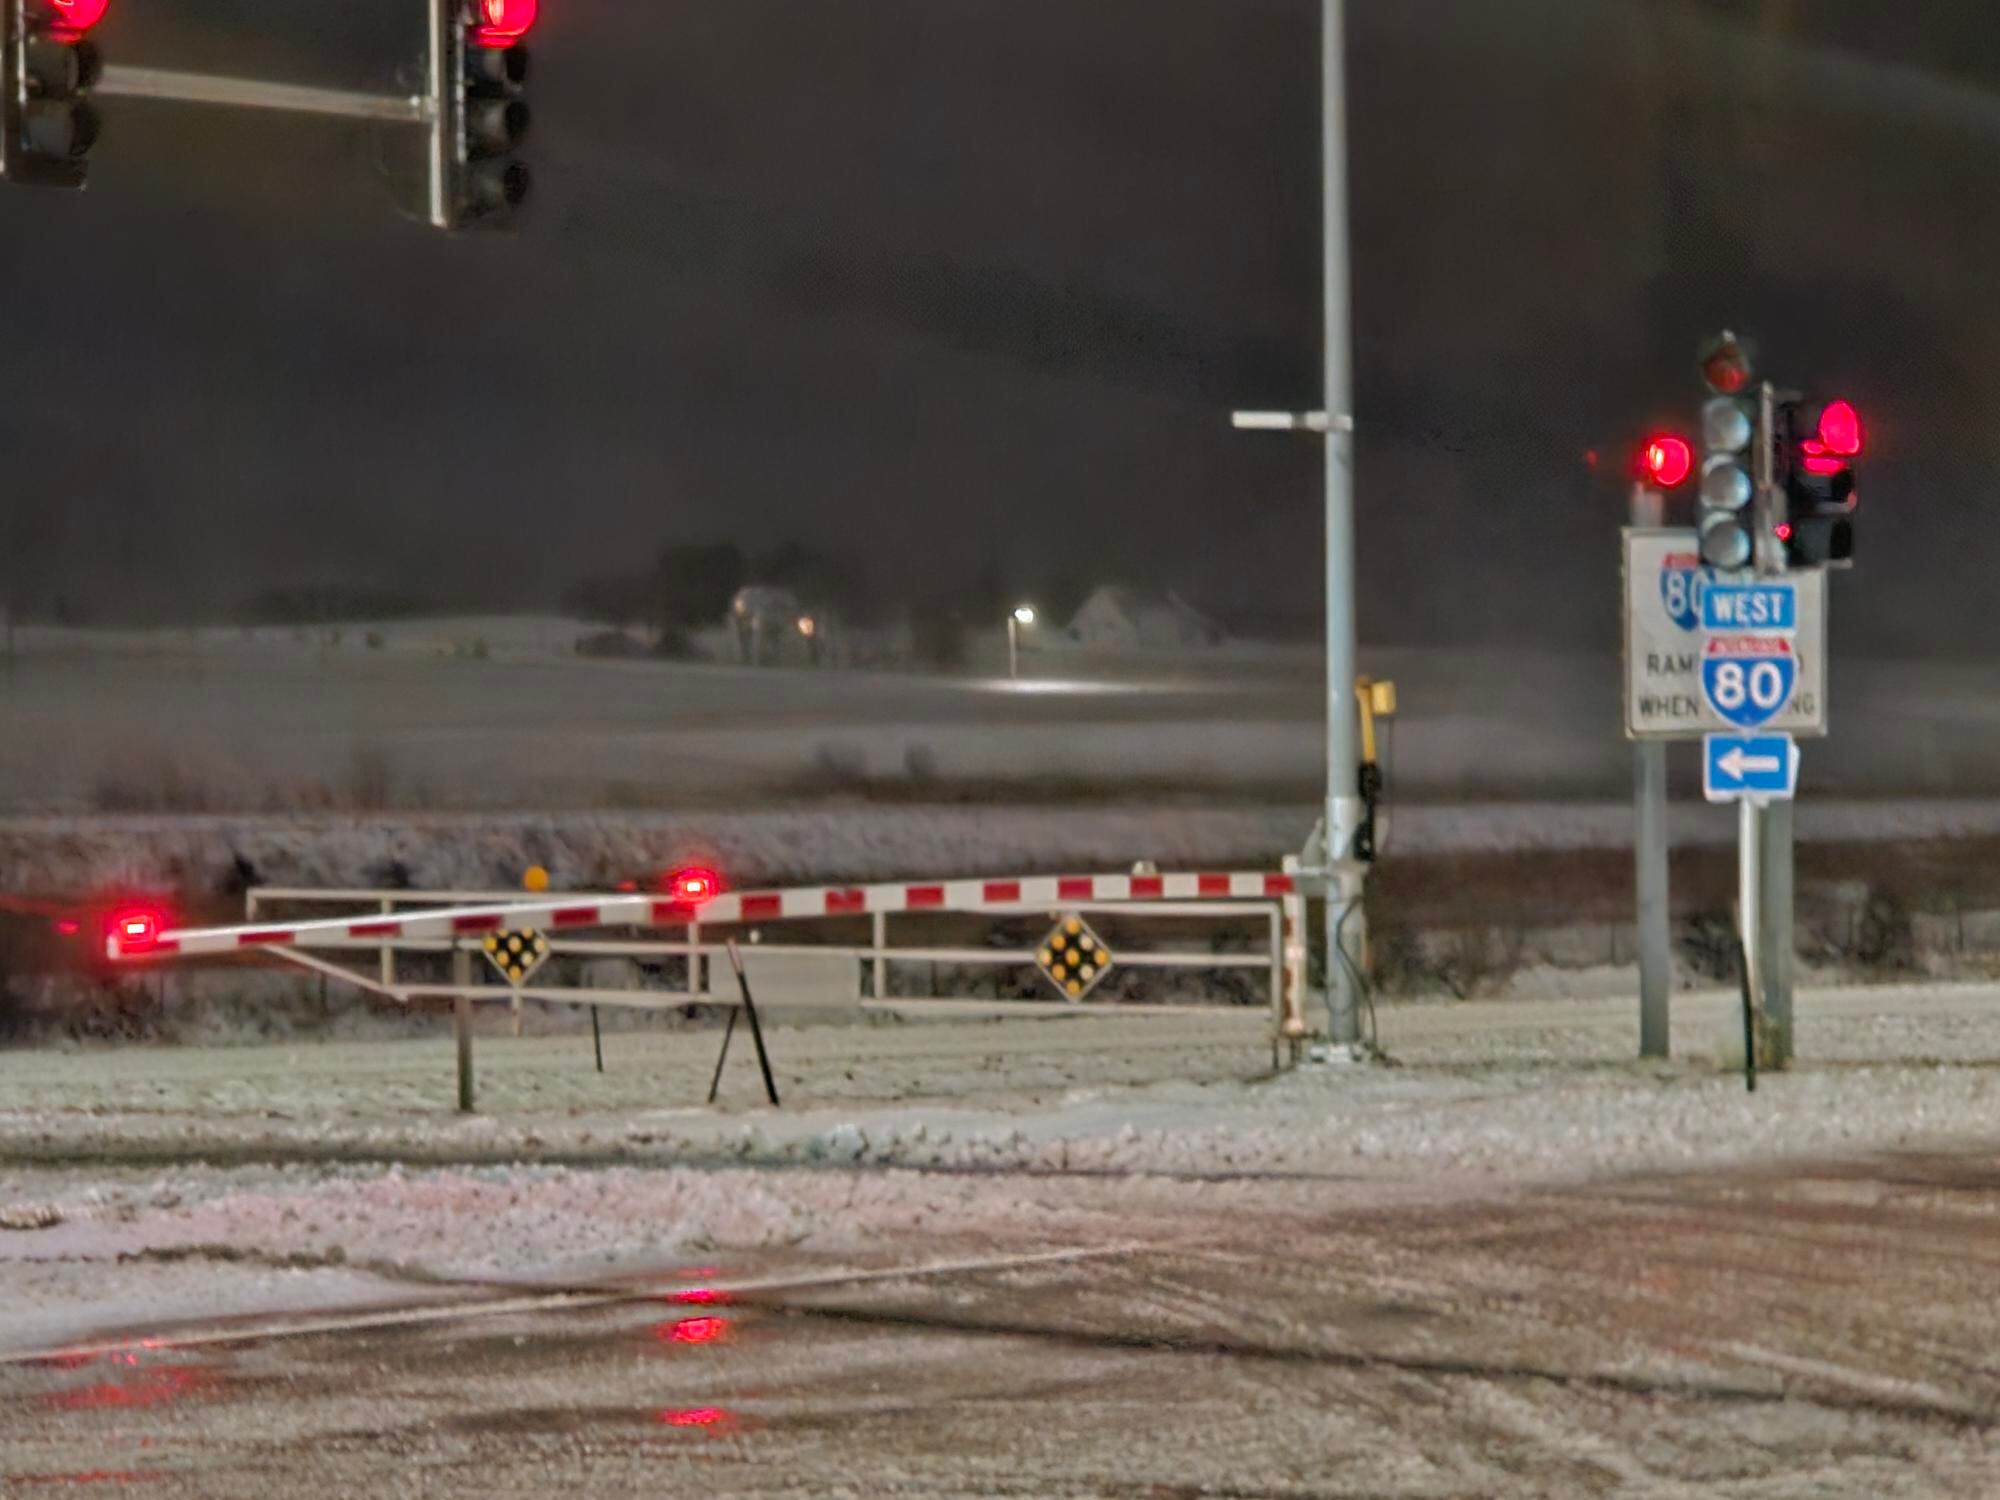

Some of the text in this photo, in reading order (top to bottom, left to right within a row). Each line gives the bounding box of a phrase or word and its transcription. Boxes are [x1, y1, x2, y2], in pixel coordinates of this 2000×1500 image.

[1713, 592, 1785, 622] WEST
[1647, 654, 1694, 675] RAM
[1715, 662, 1782, 709] 80
[1639, 696, 1699, 717] WHEN
